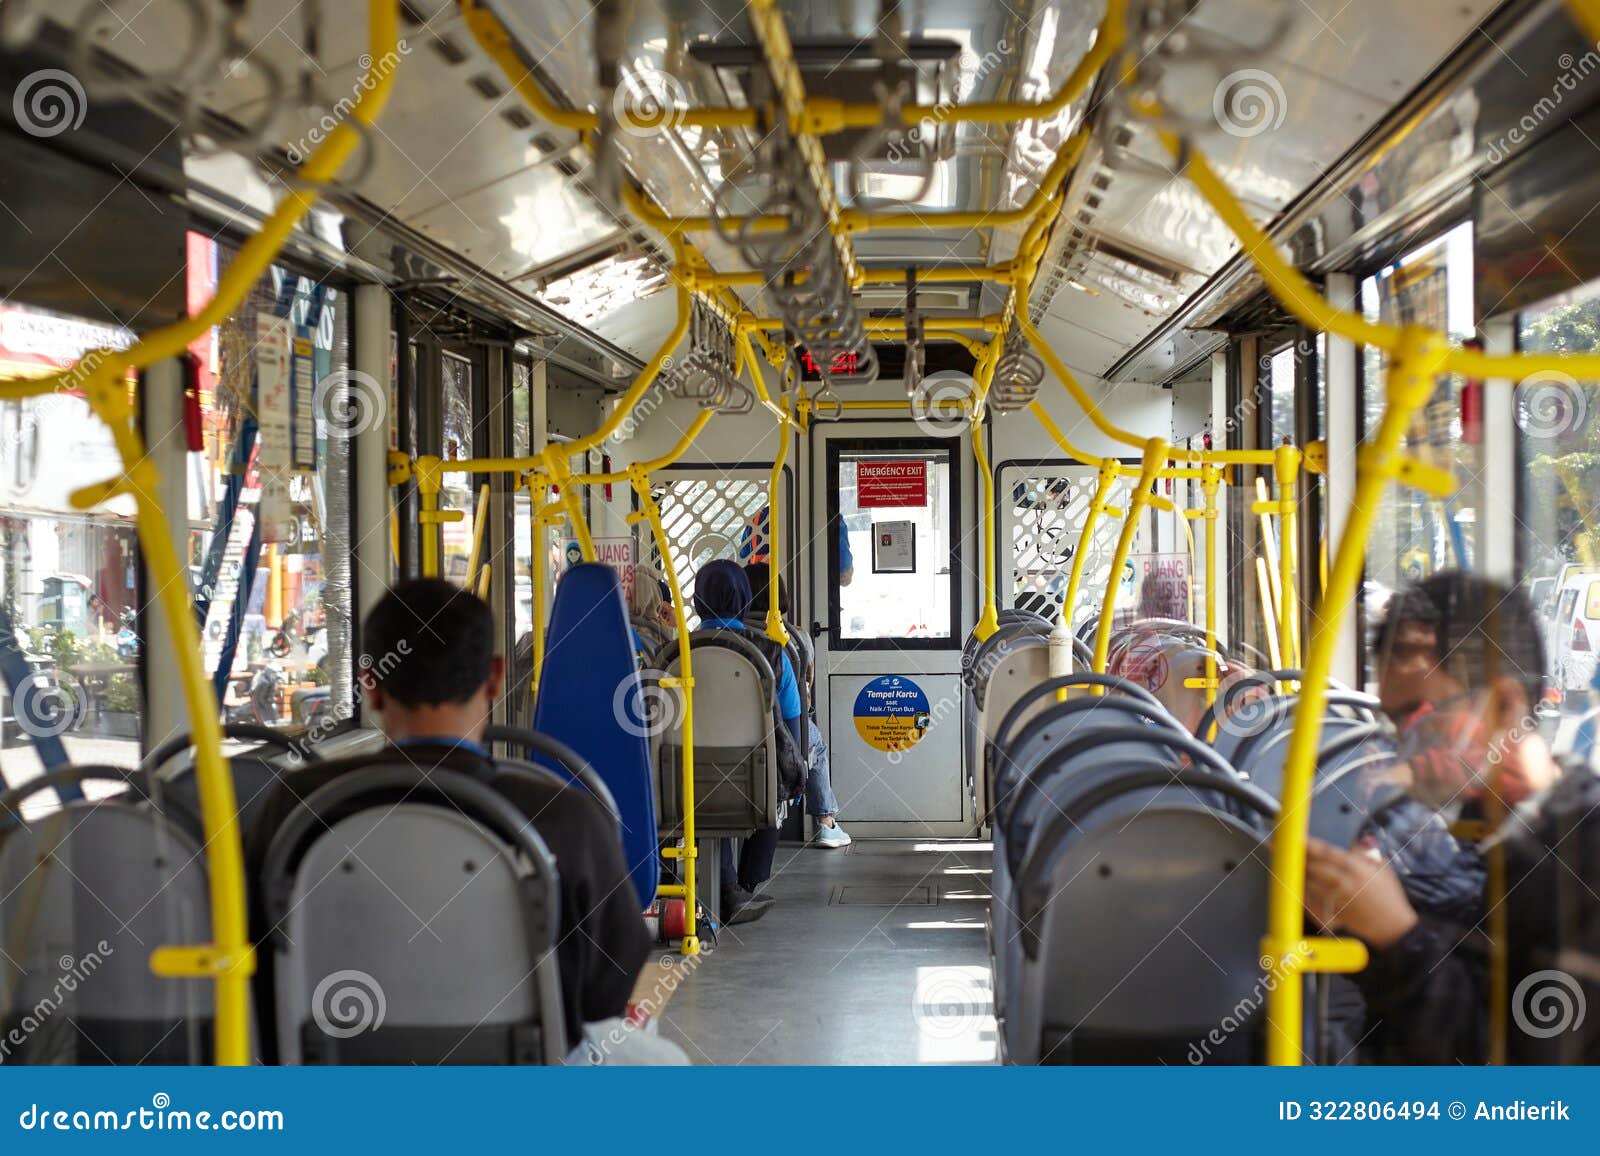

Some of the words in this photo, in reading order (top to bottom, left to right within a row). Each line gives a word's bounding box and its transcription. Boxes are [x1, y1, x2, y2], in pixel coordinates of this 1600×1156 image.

[860, 467, 905, 476] EMERGENCY
[907, 466, 923, 475] EXIT
[1143, 560, 1184, 577] RUANG
[867, 690, 895, 700] Tempel
[896, 690, 918, 698] Kartu
